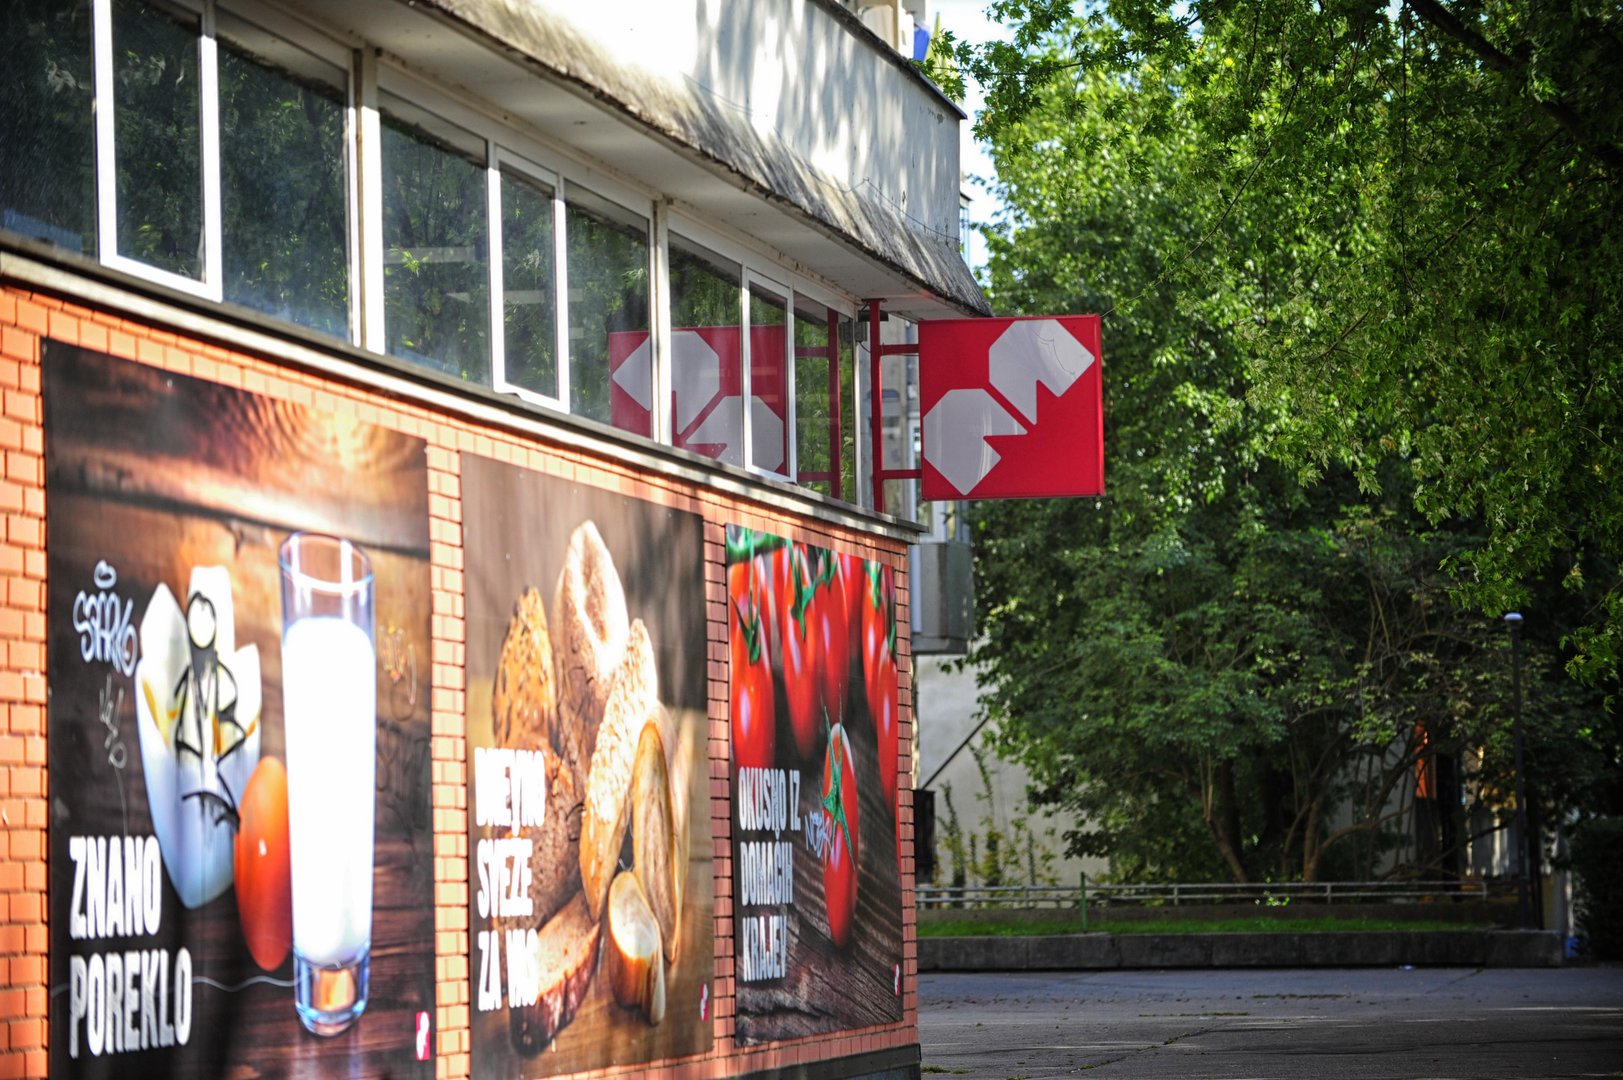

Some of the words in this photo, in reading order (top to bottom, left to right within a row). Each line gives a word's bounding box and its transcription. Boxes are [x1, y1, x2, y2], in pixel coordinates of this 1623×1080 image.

[738, 766, 787, 832] OKUSNO
[789, 769, 801, 831] IZ
[69, 834, 162, 940] ZNANO
[740, 829, 793, 906] DOMAČIH
[478, 930, 502, 1012] ZA
[742, 915, 788, 982] KRAJEV
[69, 947, 193, 1059] POREKLO
